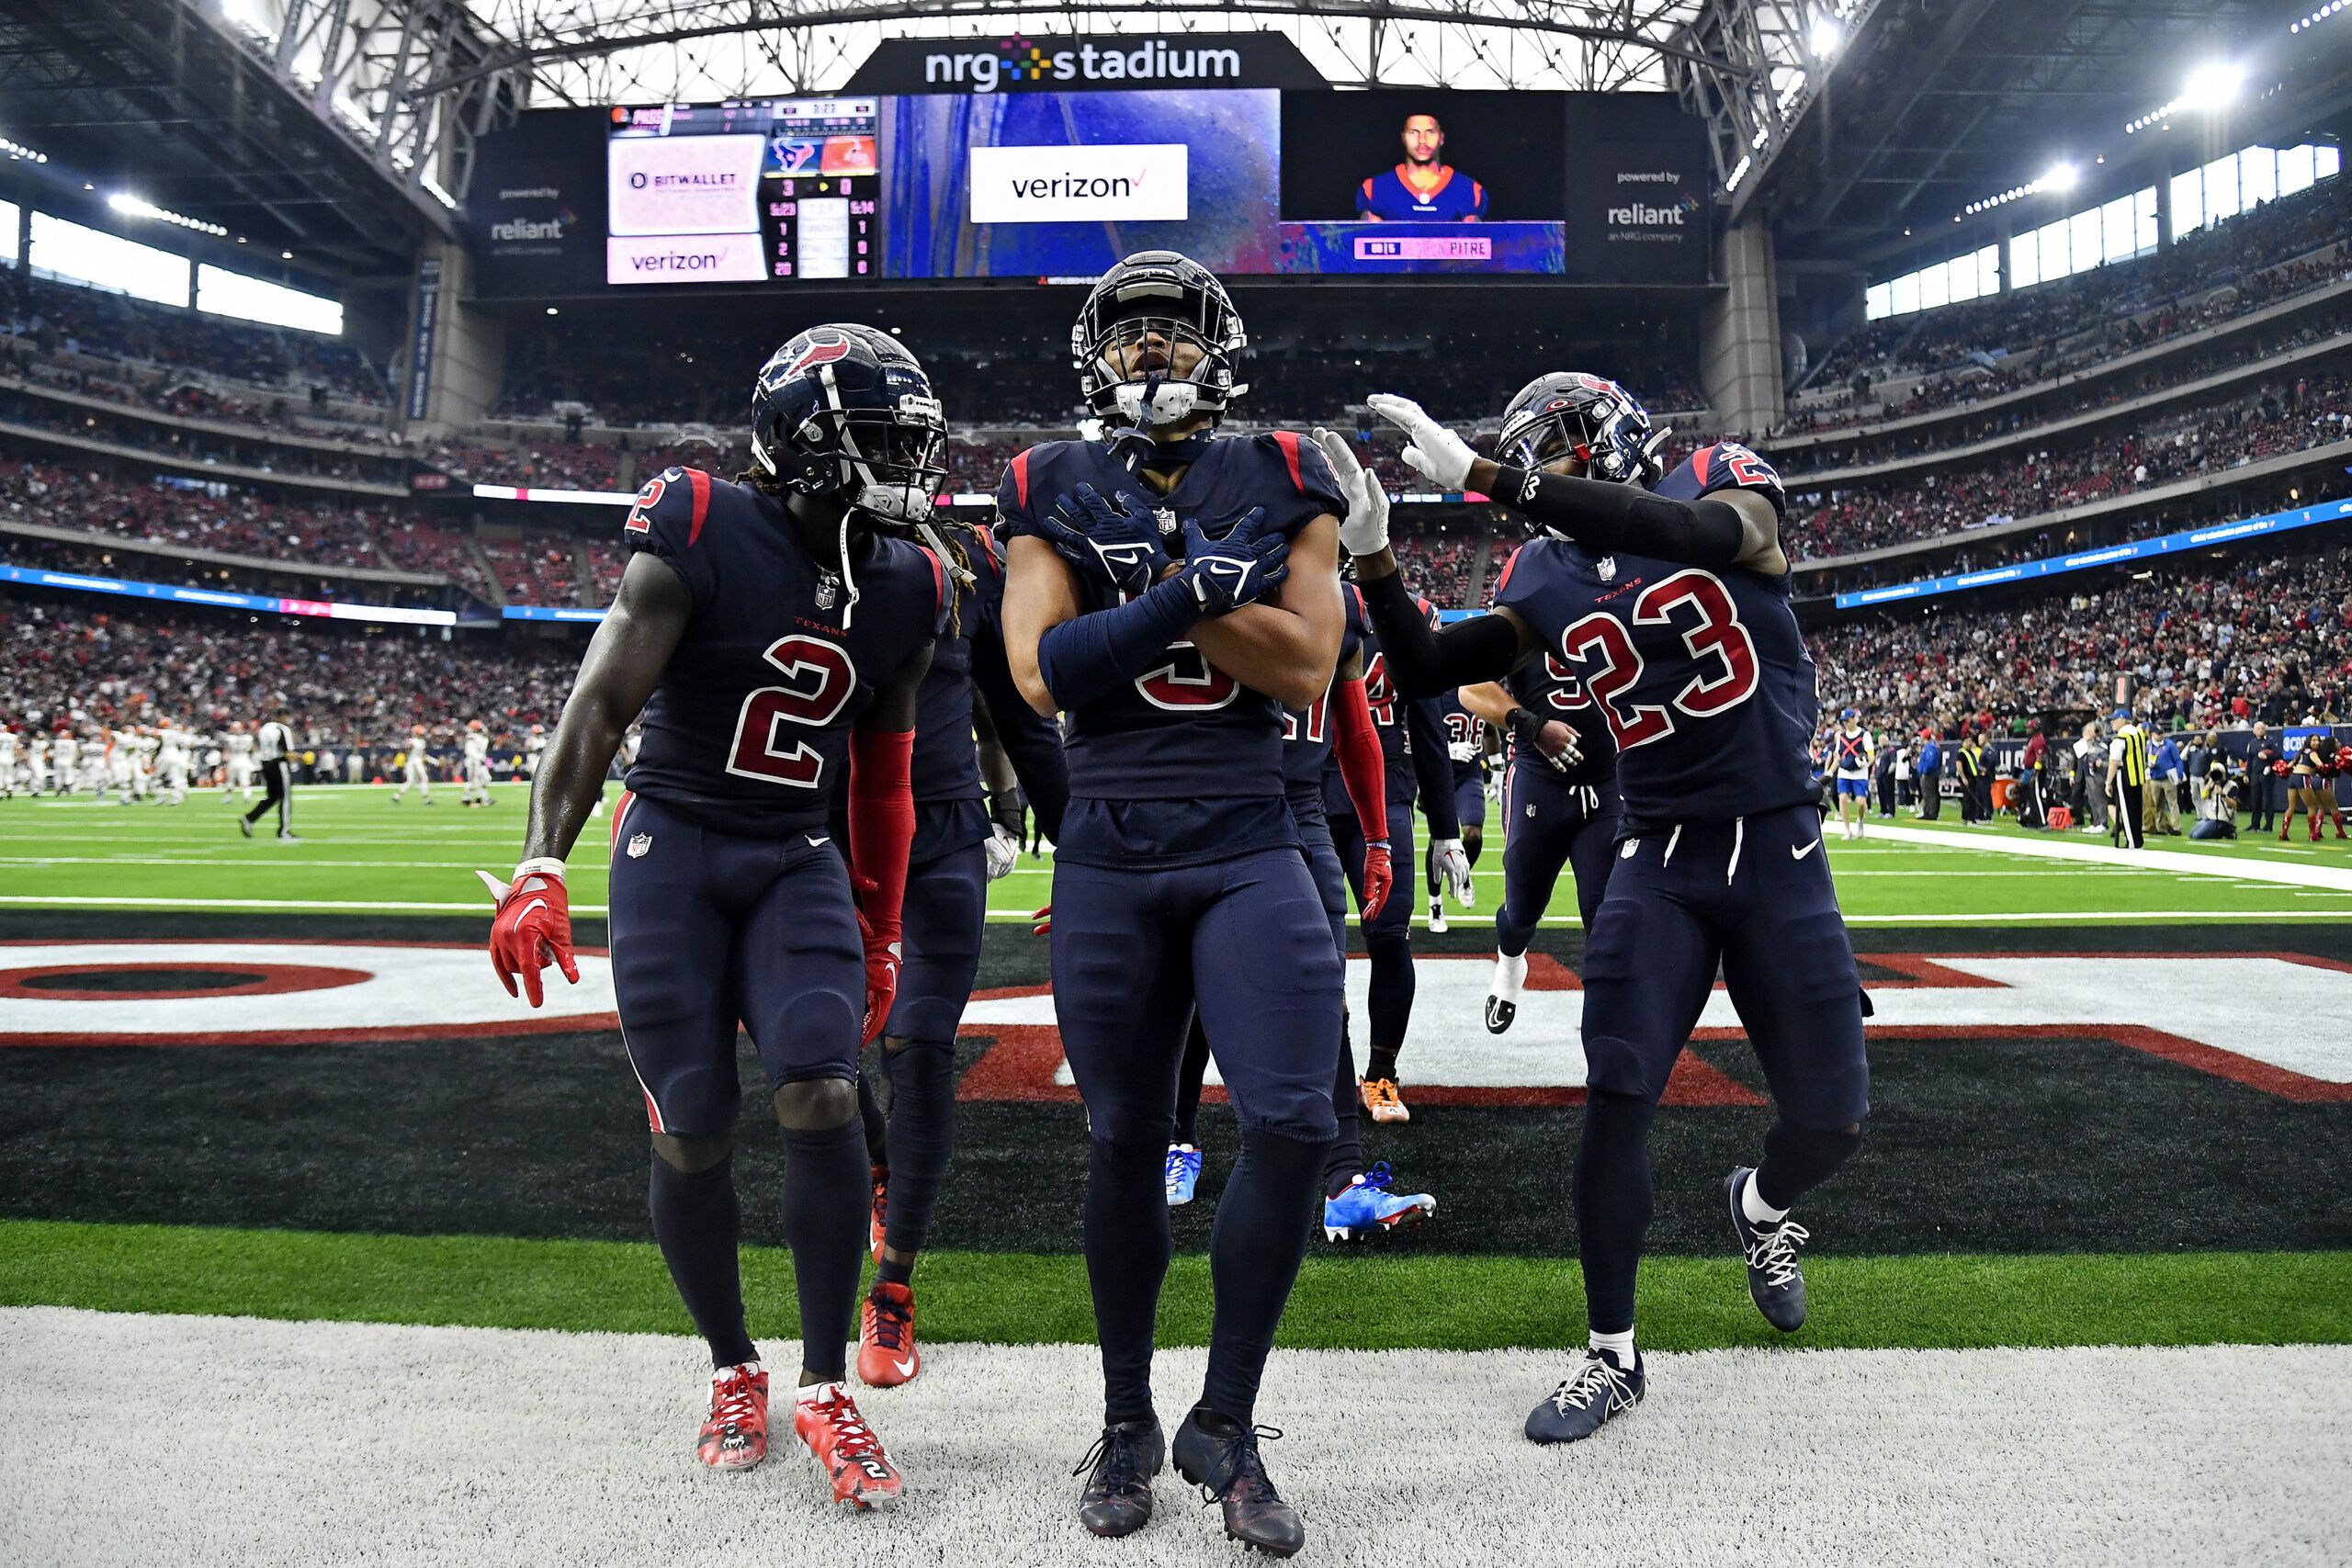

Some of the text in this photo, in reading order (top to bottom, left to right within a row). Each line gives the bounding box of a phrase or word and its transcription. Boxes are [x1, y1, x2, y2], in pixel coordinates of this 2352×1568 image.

[926, 40, 1239, 92] nrg stadium
[655, 174, 735, 186] BITWALLET
[1012, 172, 1130, 198] verizon
[1617, 171, 1680, 184] powered by
[1608, 203, 1684, 225] reliant
[492, 218, 563, 240] reliant
[1451, 243, 1486, 254] PITRE
[632, 251, 716, 270] verizon
[624, 479, 667, 534] 2
[1594, 577, 1643, 604] TEXANS
[794, 616, 850, 637] TEXANS
[1561, 569, 1759, 753] 23
[726, 635, 856, 789] 2
[1443, 713, 1486, 753] 38
[861, 1461, 888, 1479] 2
